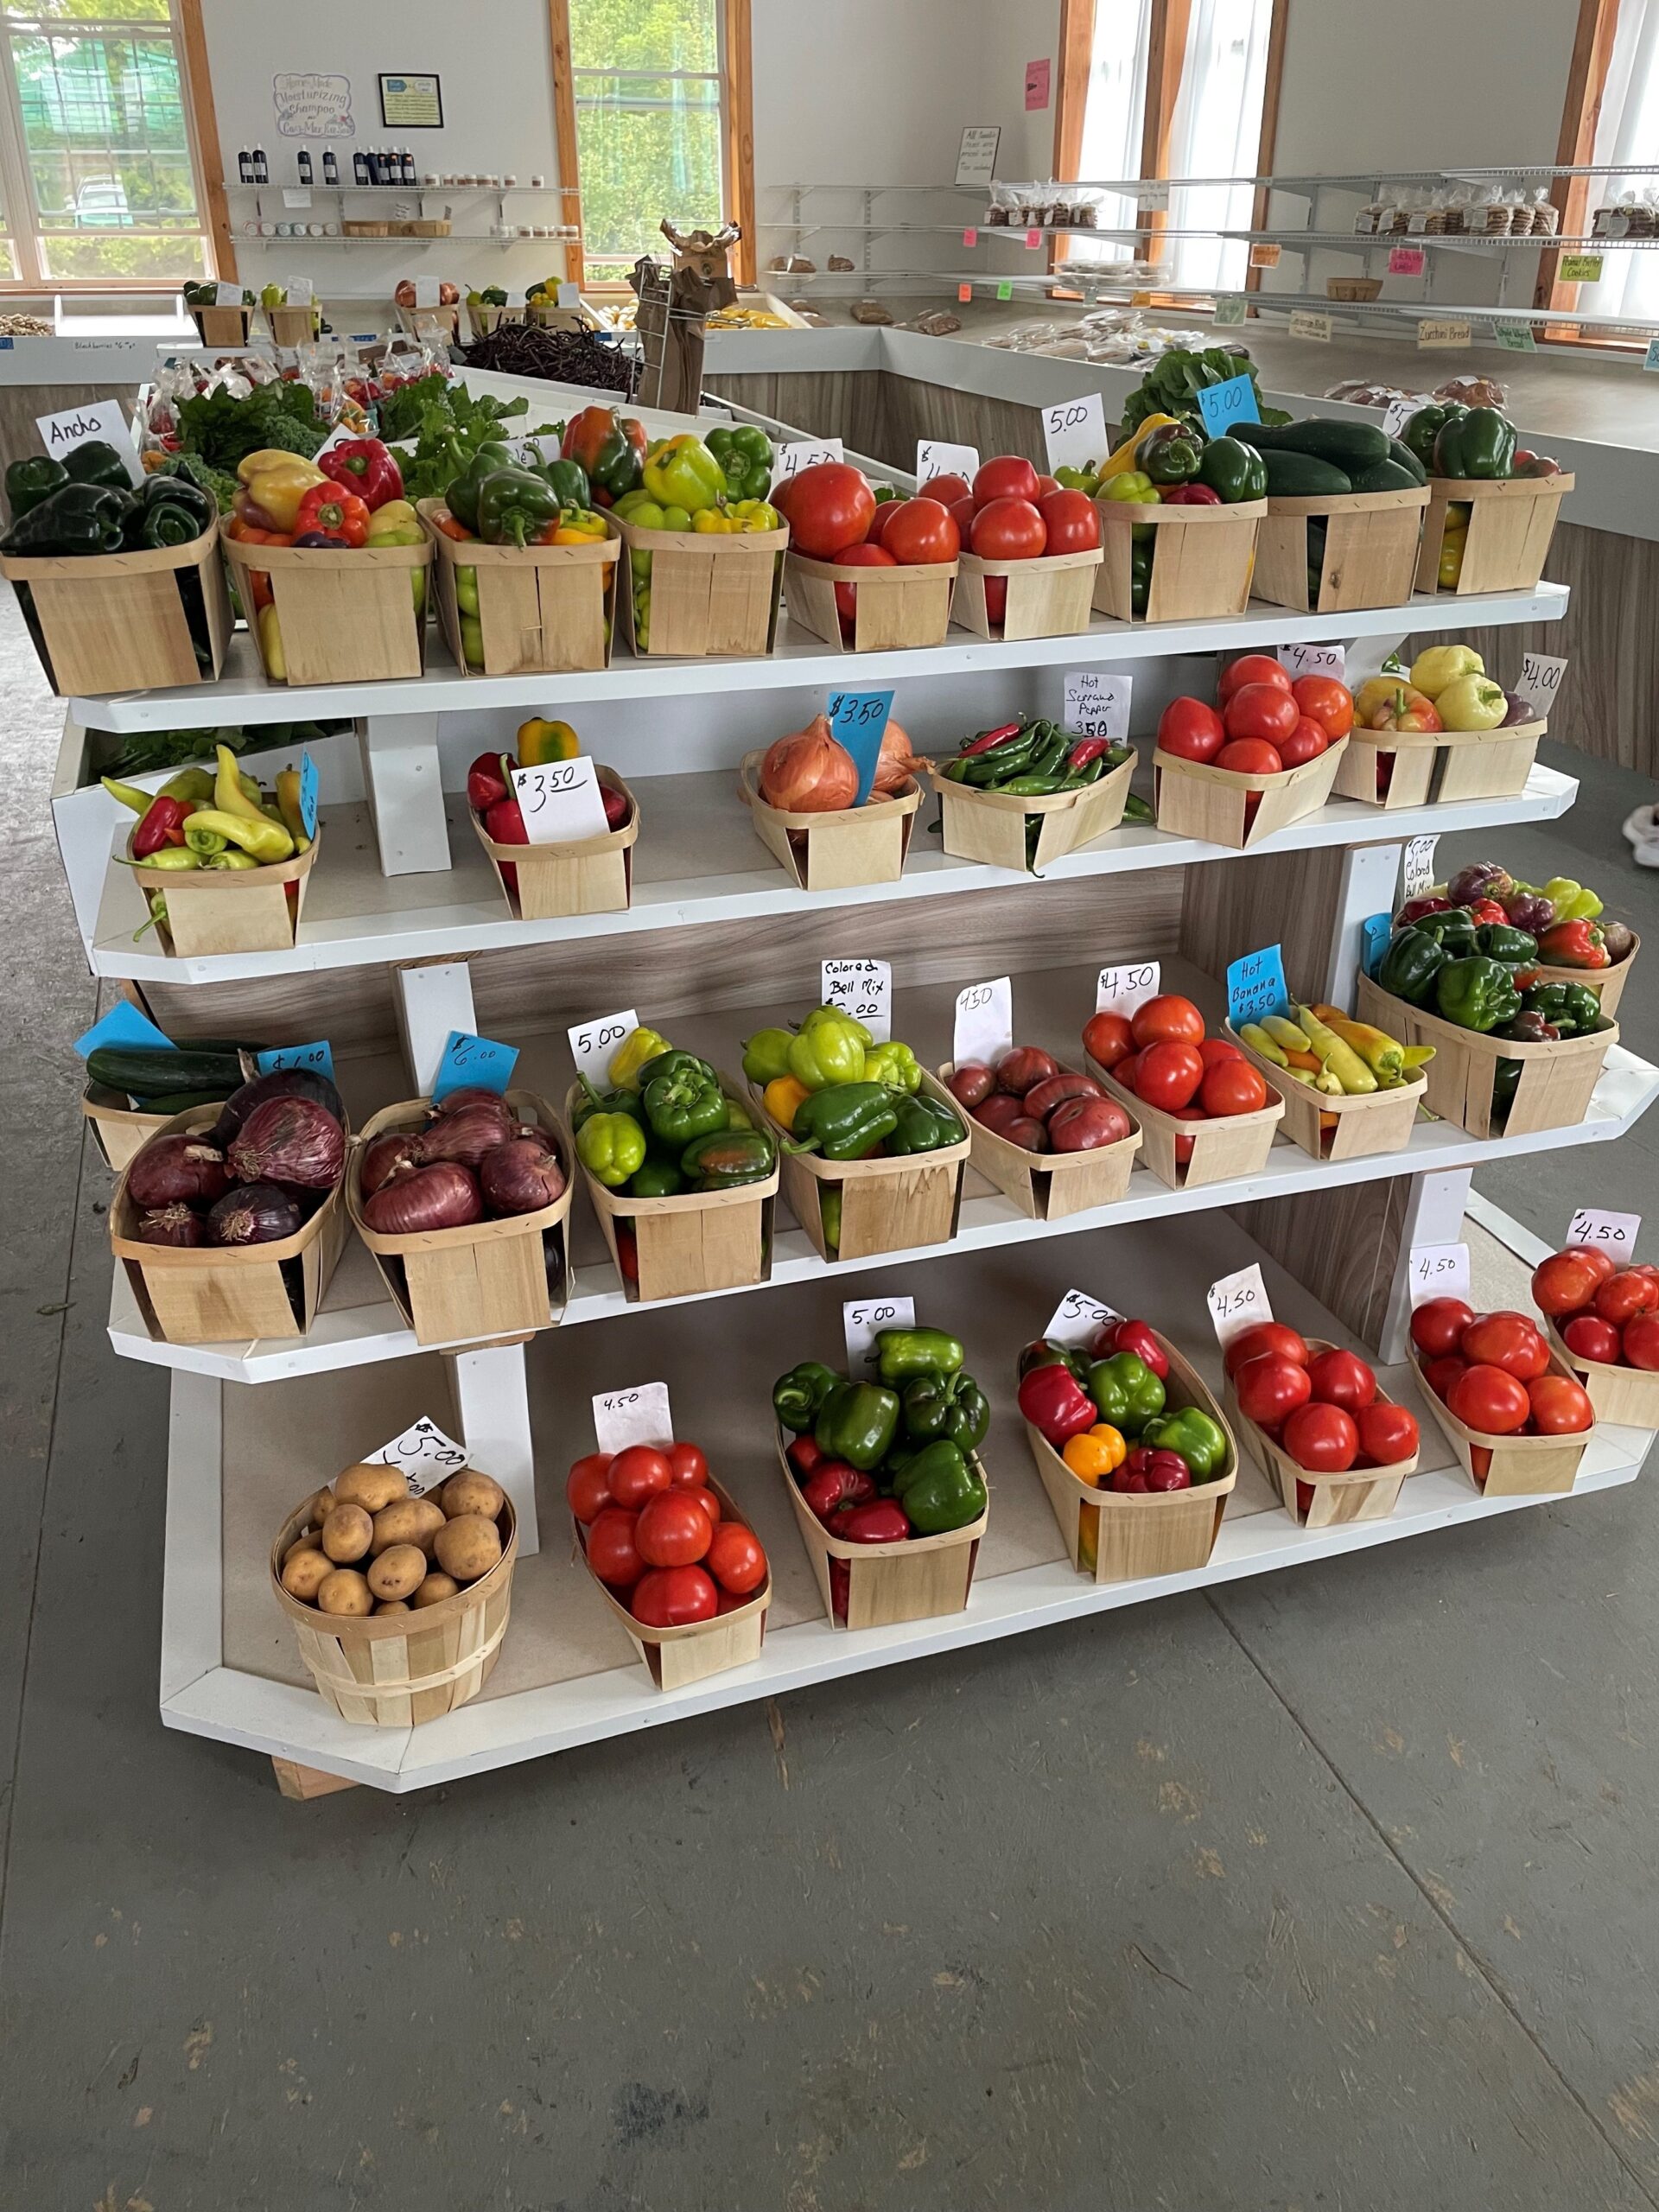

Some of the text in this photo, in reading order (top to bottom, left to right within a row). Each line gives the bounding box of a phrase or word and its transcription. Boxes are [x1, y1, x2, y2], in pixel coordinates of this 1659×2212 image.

[289, 103, 335, 117] Shampoo
[1567, 267, 1590, 277] Cookies
[1419, 325, 1470, 340] Zucchini Bread
[51, 414, 102, 443] Ancho
[1051, 406, 1088, 434] 5.00
[1081, 675, 1098, 688] Hot
[1523, 658, 1560, 690] $4.00
[829, 695, 884, 725] $3.50
[825, 959, 878, 974] Colored
[1242, 957, 1263, 981] Hot
[830, 978, 884, 995] Bell Mix
[1100, 966, 1154, 998] $4.50
[1232, 977, 1275, 1002] Banana
[1238, 993, 1275, 1018] $3.50
[578, 1026, 625, 1053] 5.00
[852, 1306, 895, 1325] 5.00
[603, 1393, 639, 1410] 4.50
